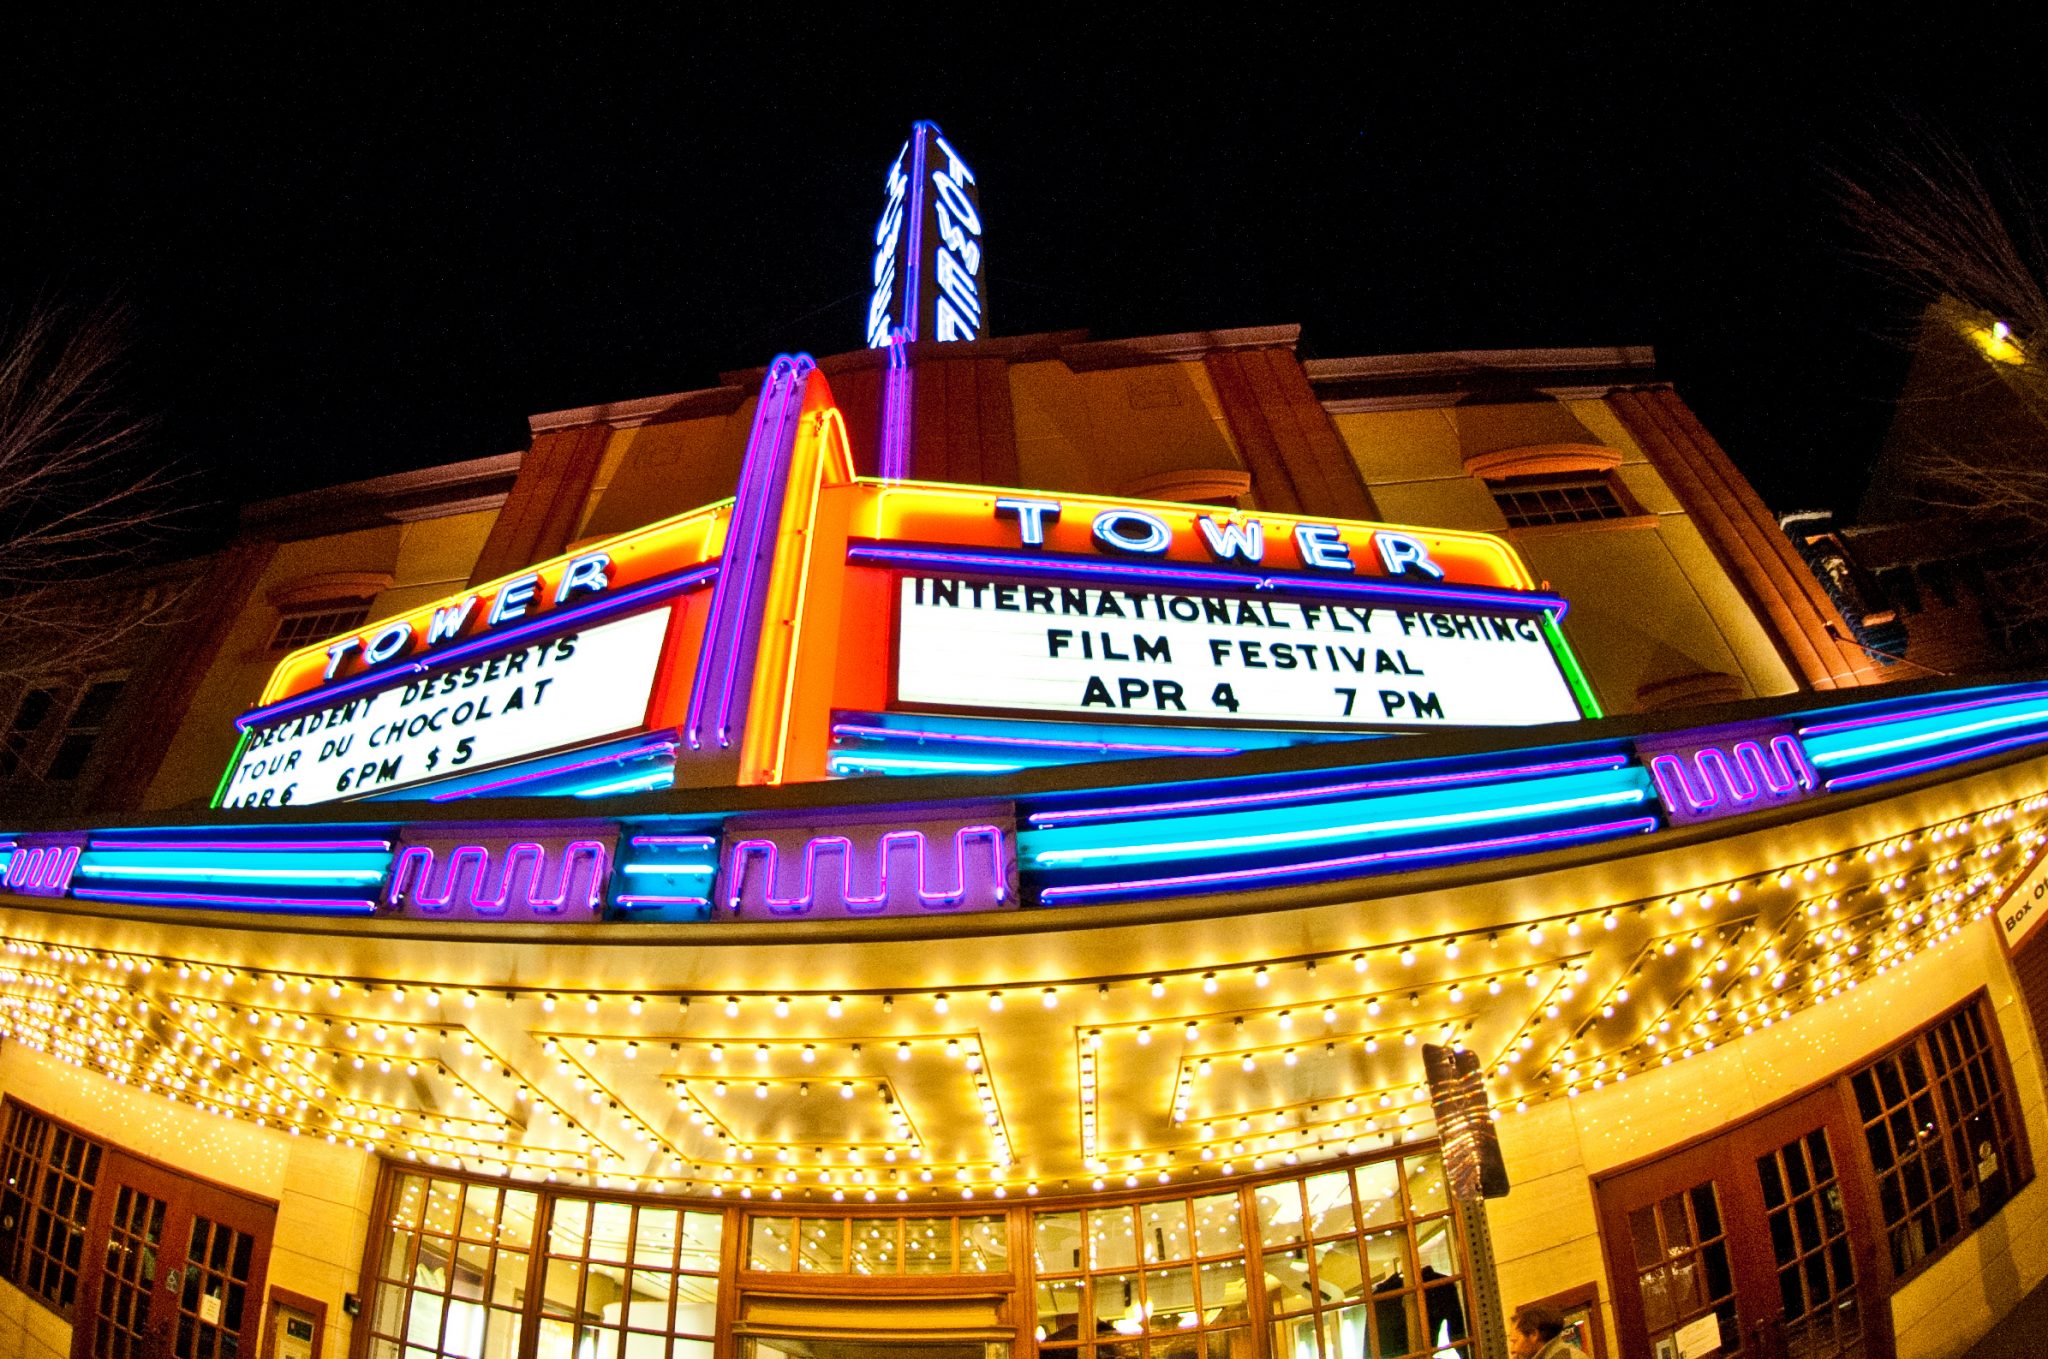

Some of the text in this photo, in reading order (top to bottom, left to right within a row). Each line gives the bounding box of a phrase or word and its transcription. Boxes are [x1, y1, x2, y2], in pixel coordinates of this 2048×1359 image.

[996, 498, 1444, 582] TOWER
[323, 552, 613, 682] TOWER
[915, 577, 1538, 641] INTERNATIONAL FLY FISHING
[1047, 629, 1425, 675] FILM FESTIVAL
[249, 634, 578, 752] DECADENT DESSERTS
[1081, 676, 1444, 719] APR 4 7 PM
[239, 677, 553, 784] TOUR DU CHOCOLAT
[336, 754, 403, 792] 6PM
